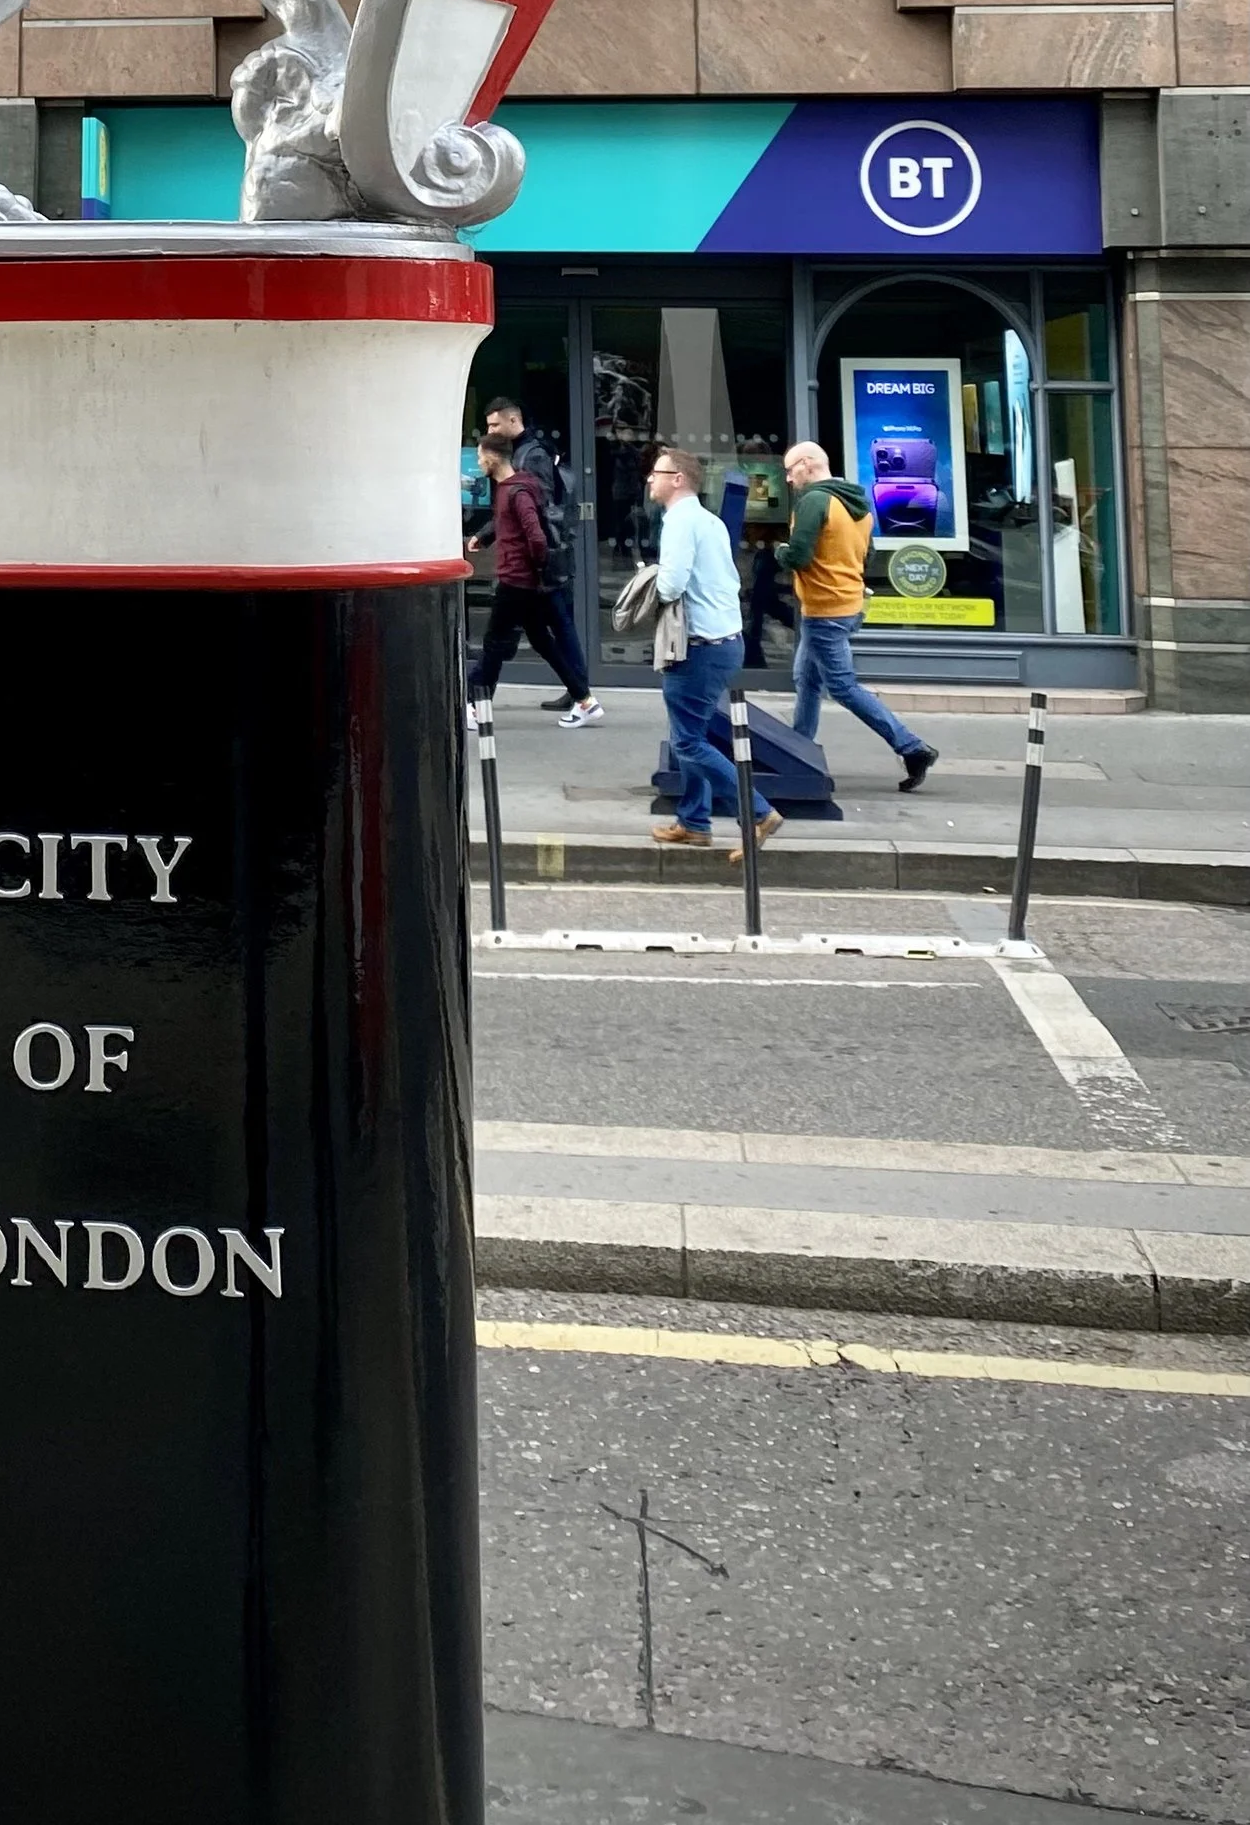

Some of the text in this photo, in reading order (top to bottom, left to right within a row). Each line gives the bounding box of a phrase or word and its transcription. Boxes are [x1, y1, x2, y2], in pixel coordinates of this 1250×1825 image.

[887, 156, 954, 200] BT
[866, 382, 936, 395] DREAM BIG
[905, 563, 930, 573] NEXT
[908, 573, 928, 582] DAY
[12, 1022, 135, 1093] OF
